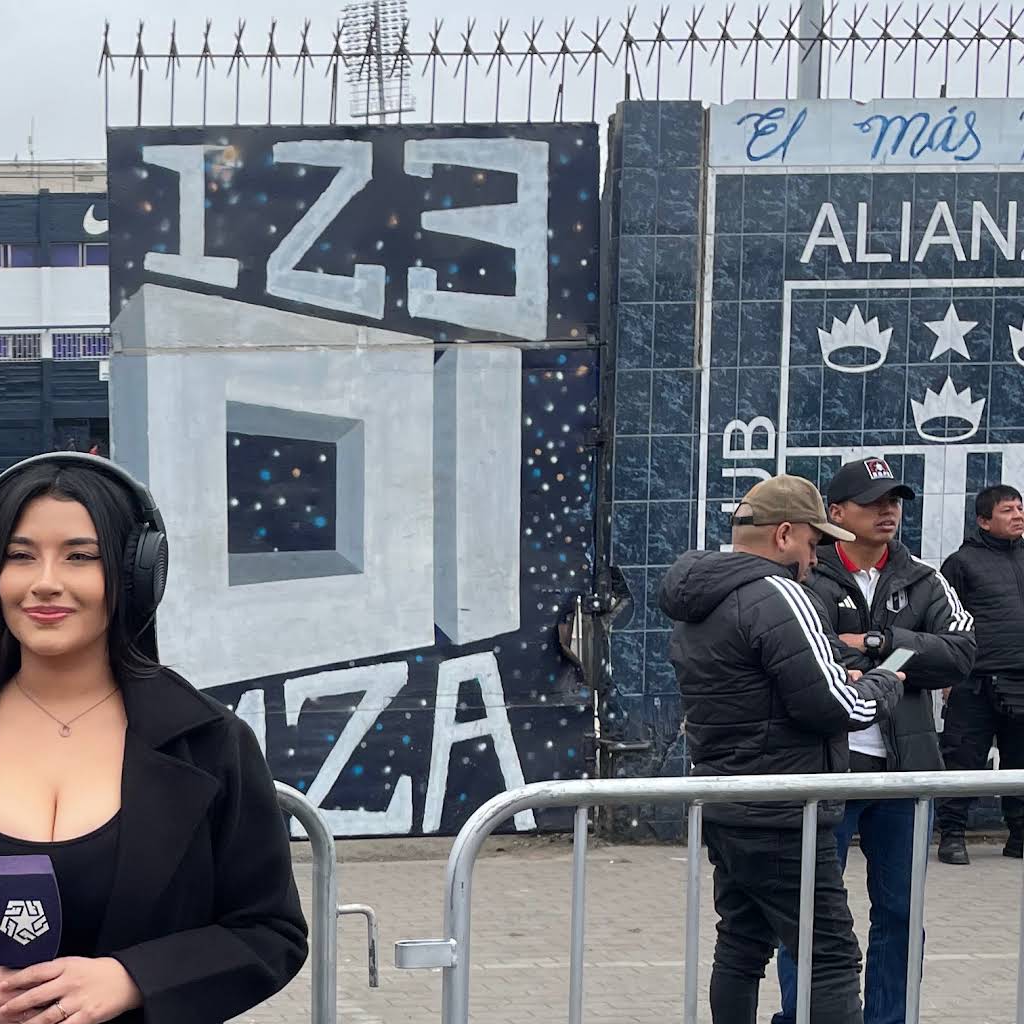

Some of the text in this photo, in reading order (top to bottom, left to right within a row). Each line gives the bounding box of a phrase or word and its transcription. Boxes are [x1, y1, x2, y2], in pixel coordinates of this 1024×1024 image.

[737, 106, 808, 163] El
[852, 105, 982, 162] Más
[799, 200, 1024, 263] ALIAN
